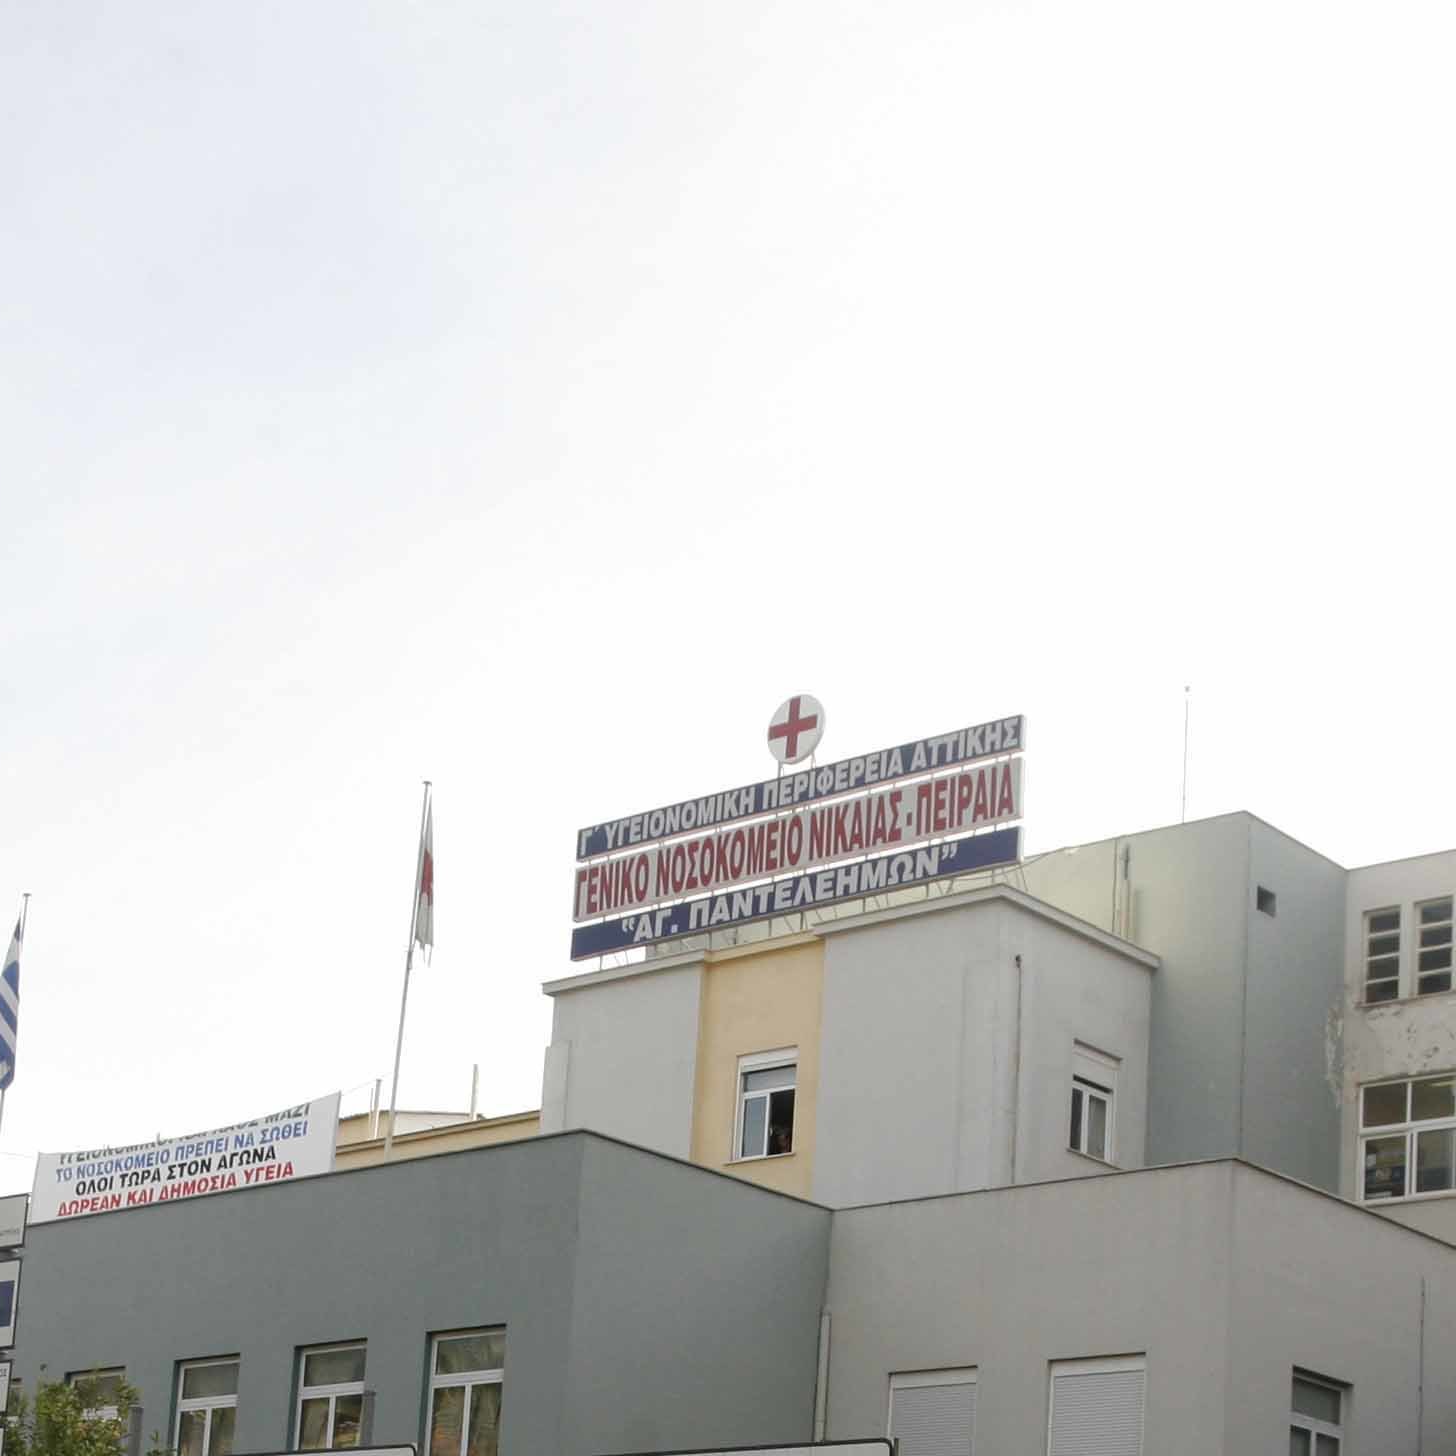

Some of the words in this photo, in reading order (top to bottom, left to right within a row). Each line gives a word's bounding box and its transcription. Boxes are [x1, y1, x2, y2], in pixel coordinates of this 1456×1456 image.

[605, 786, 756, 849] ΥΓΕΙΟΝΟΜΙΚΗ
[762, 748, 904, 810] ΠΕΡΙΦΕΡΕΙΑ
[910, 718, 1019, 772] ΑΤΤΙΚΗΣ
[576, 854, 649, 918] ΓΕΝΙΚΟ
[656, 815, 803, 898] ΝΟΣΟΚΟΜΕΙΟ
[809, 790, 903, 862] ΝΙΚΑΙΑΣ
[916, 764, 1013, 836] ΠΕΙΡΑΙΑ
[56, 1167, 72, 1184] ΤΟ
[76, 1149, 170, 1179] ΝΟΣΟΚΟΜΕΙΟ
[176, 1136, 230, 1161] ΠΡΕΠΕΙ
[234, 1133, 254, 1150] ΝΑ
[259, 1120, 308, 1145] ΣΩΘΕΙ
[75, 1176, 113, 1196] ΟΛΟΙ
[120, 1168, 161, 1189] ΤΩΡΑ
[166, 1157, 212, 1180] ΣΤΟΝ
[217, 1145, 276, 1171] ΑΓΩΝΑ
[57, 1194, 121, 1217] ΔΩΡΕΑΝ
[127, 1188, 154, 1206] ΚΑΙ
[158, 1172, 236, 1201] ΔΗΜΟΣΙΑ
[244, 1161, 294, 1184] ΥΓΕΙΑ
